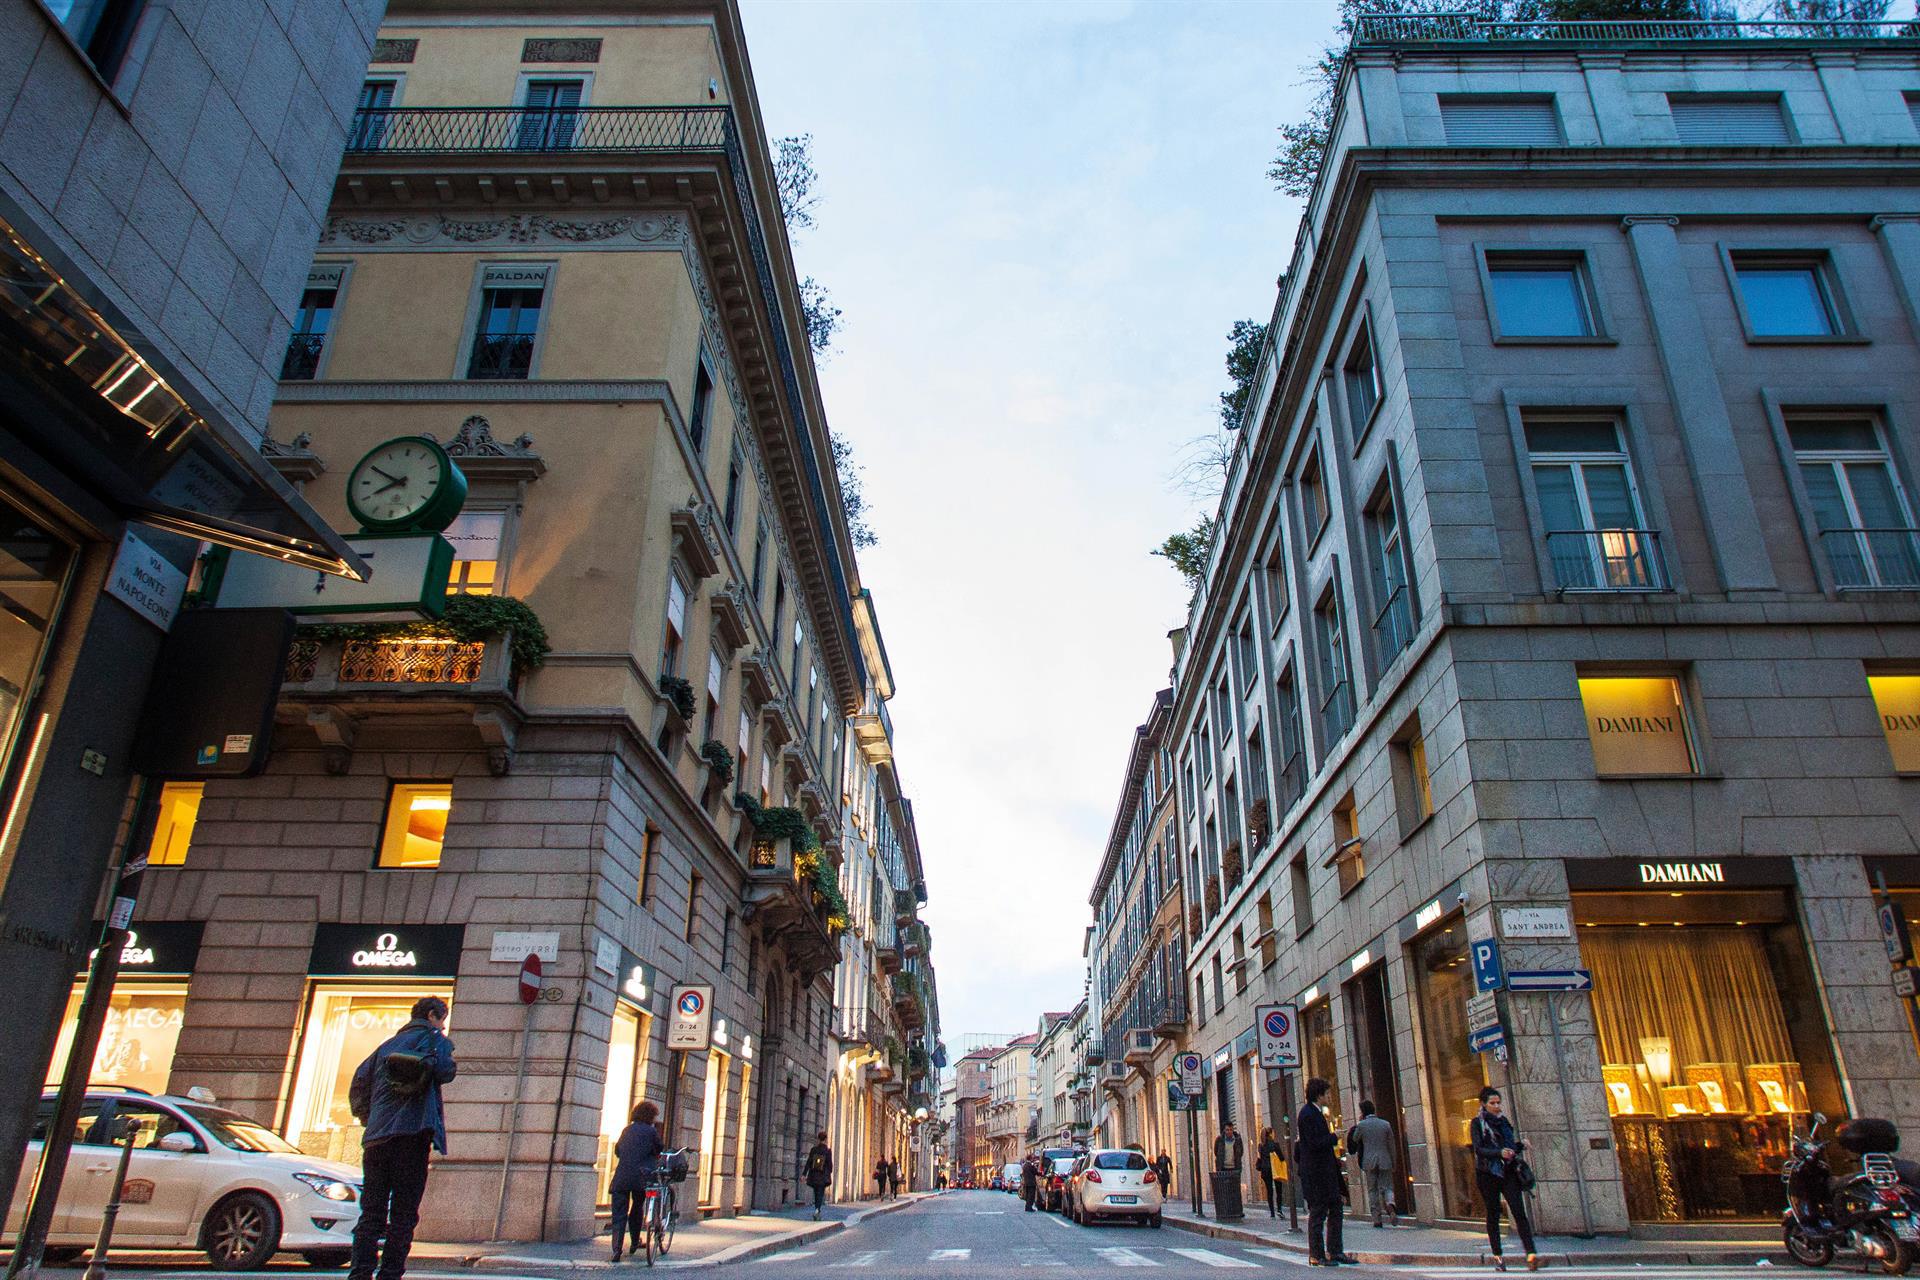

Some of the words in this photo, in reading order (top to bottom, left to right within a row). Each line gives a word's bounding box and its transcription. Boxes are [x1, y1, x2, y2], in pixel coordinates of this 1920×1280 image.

[486, 272, 545, 281] BALDAN
[149, 556, 162, 572] VIA
[133, 566, 167, 597] MONTE
[117, 577, 169, 622] NAPOLEONE
[1596, 717, 1673, 732] DAMIANI
[1639, 863, 1725, 882] DAMIANI
[352, 950, 417, 967] OMEGA
[524, 945, 555, 953] VERRI
[1477, 945, 1491, 970] P
[107, 1007, 184, 1029] MEGA
[351, 1010, 409, 1030] OME
